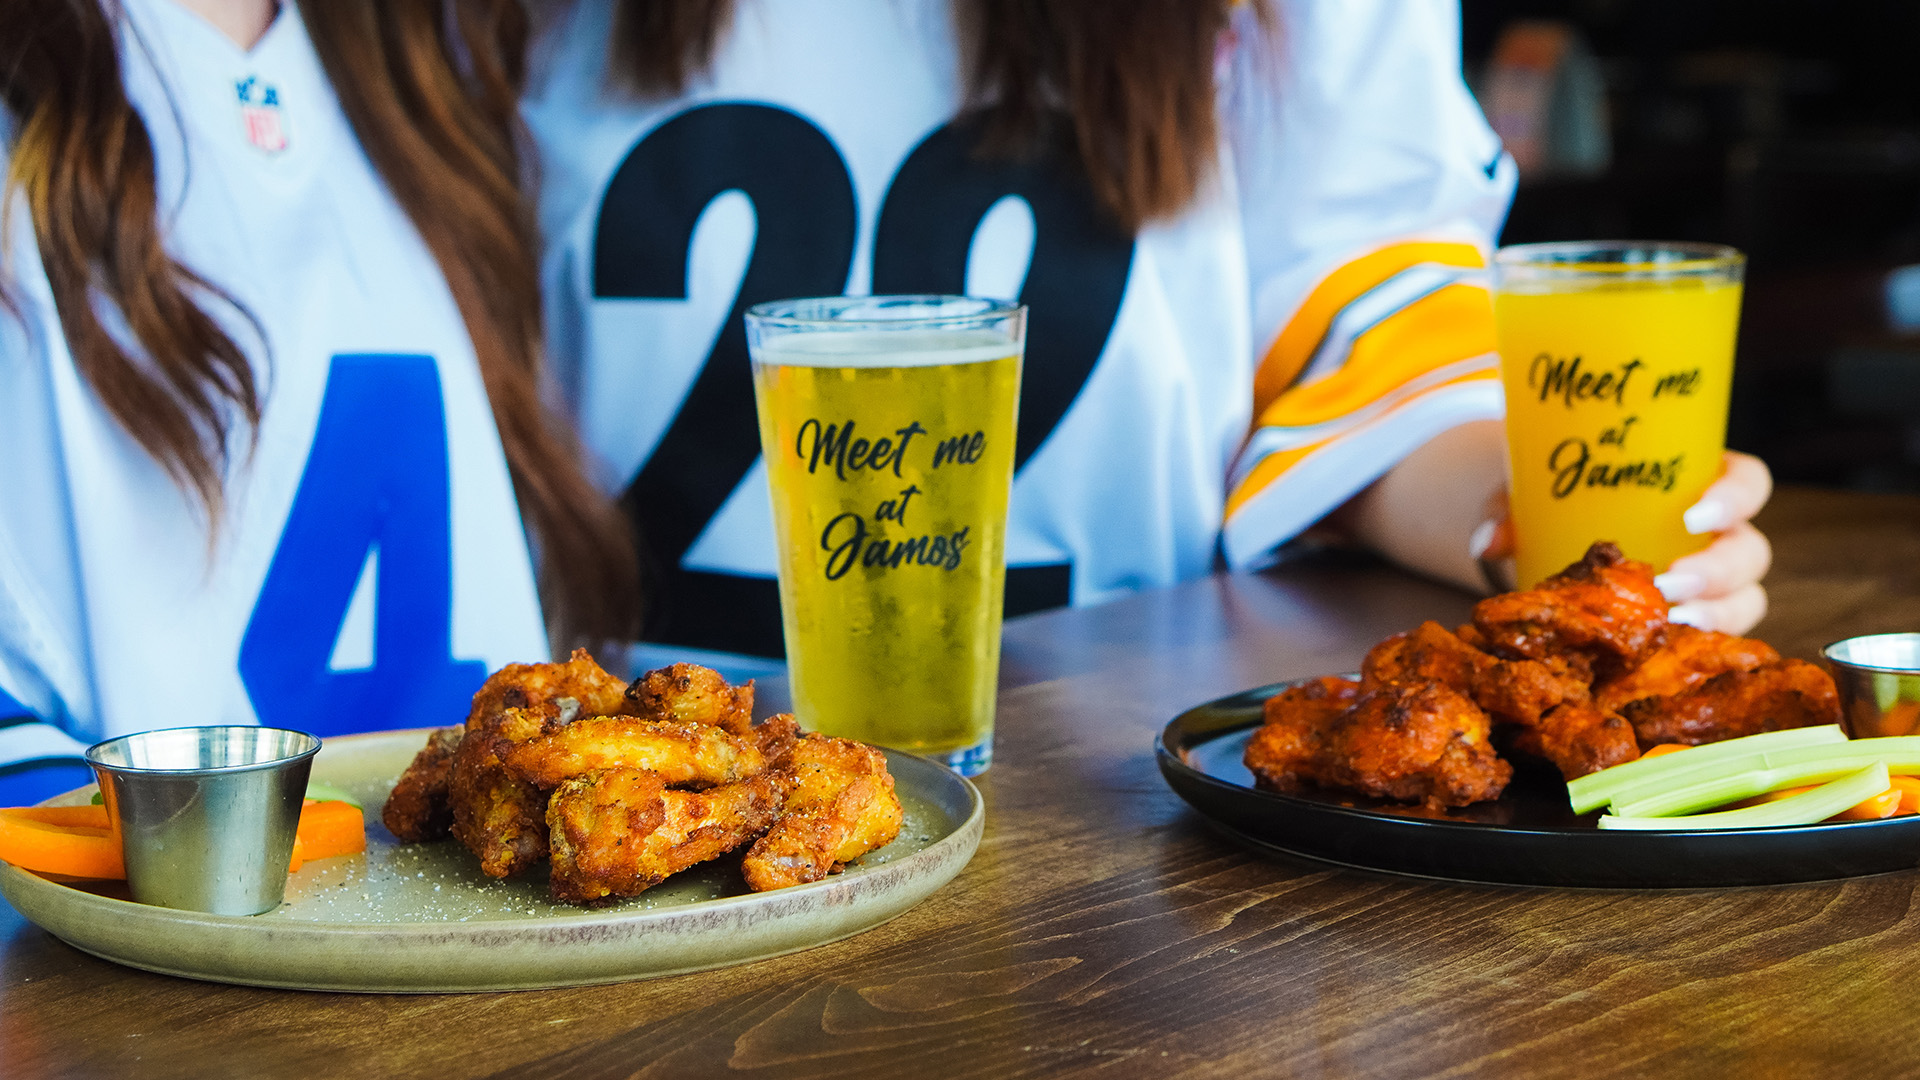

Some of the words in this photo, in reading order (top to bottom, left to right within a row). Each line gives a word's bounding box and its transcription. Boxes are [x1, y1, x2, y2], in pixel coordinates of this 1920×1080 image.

[1529, 353, 1644, 408] Meet
[1653, 367, 1701, 399] me
[796, 418, 927, 482] Meet
[931, 430, 987, 469] me
[1598, 415, 1639, 448] at
[1549, 437, 1683, 499] Jamos
[874, 485, 922, 527] at
[238, 354, 487, 737] 4
[820, 512, 970, 581] Jamos
